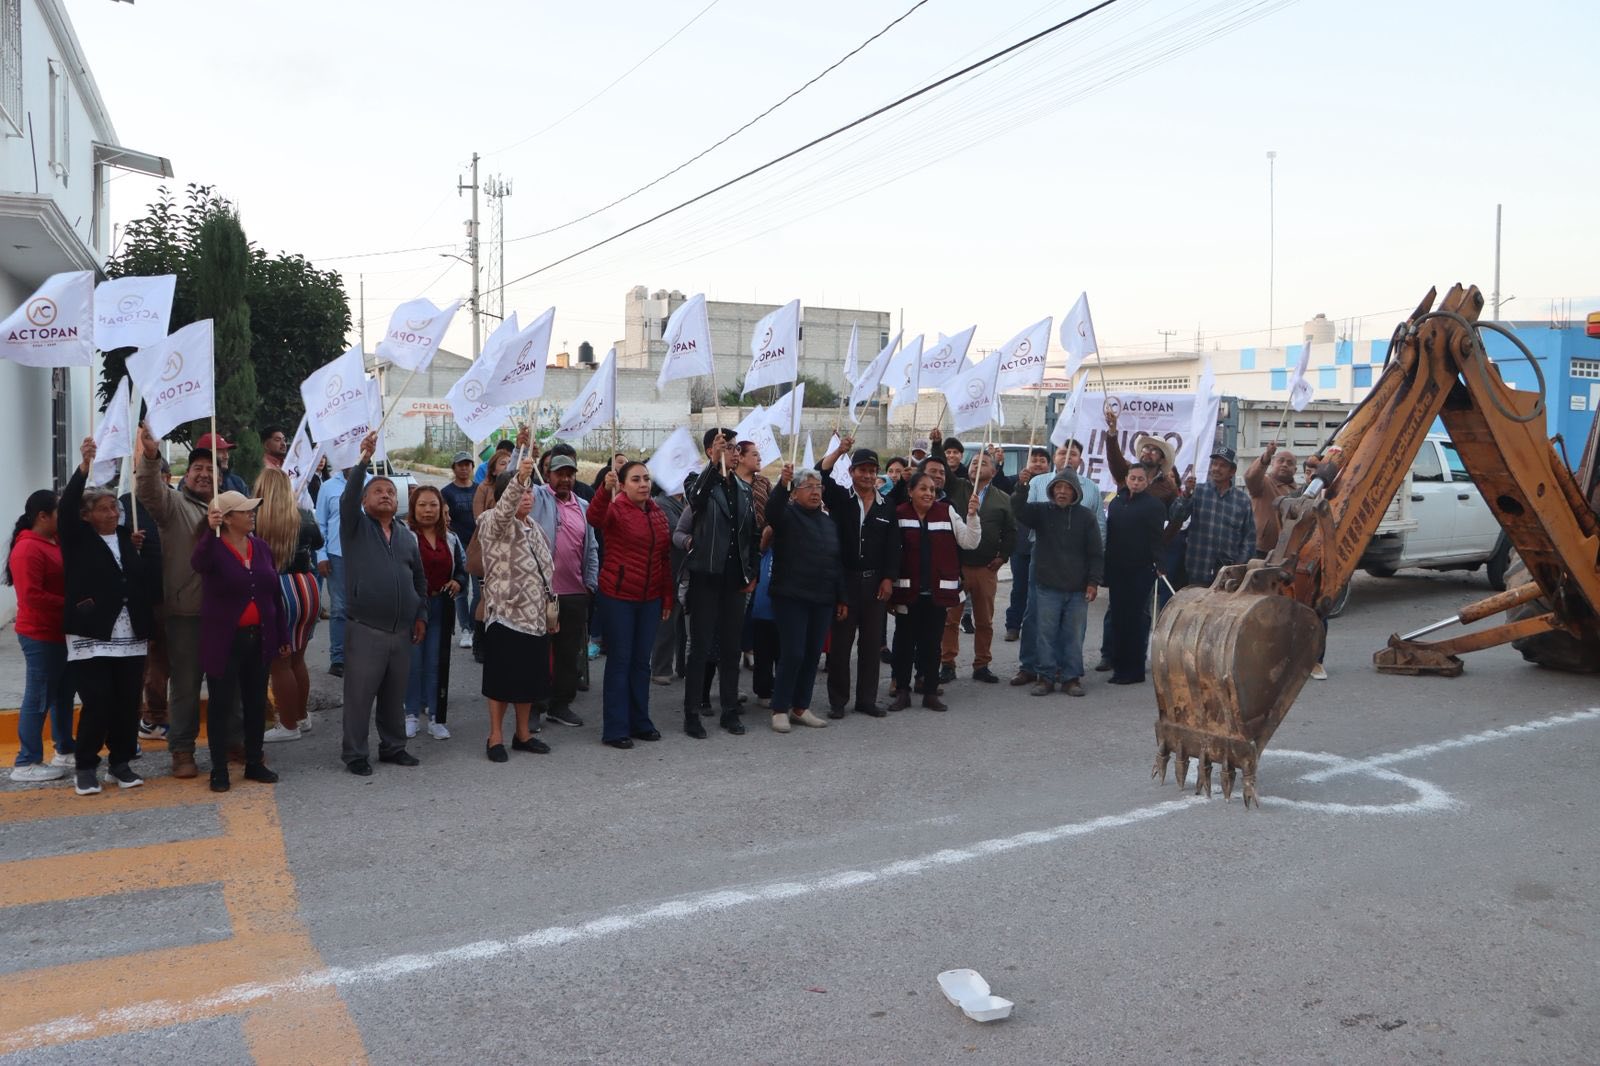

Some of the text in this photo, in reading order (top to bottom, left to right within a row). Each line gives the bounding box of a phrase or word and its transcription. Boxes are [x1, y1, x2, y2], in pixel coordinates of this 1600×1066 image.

[8, 326, 78, 341] ACTOPAN
[672, 339, 697, 353] OPAN
[750, 346, 785, 371] ACOPAN
[1000, 355, 1045, 371] ACTOPAN
[1123, 401, 1174, 412] ACTOPAN
